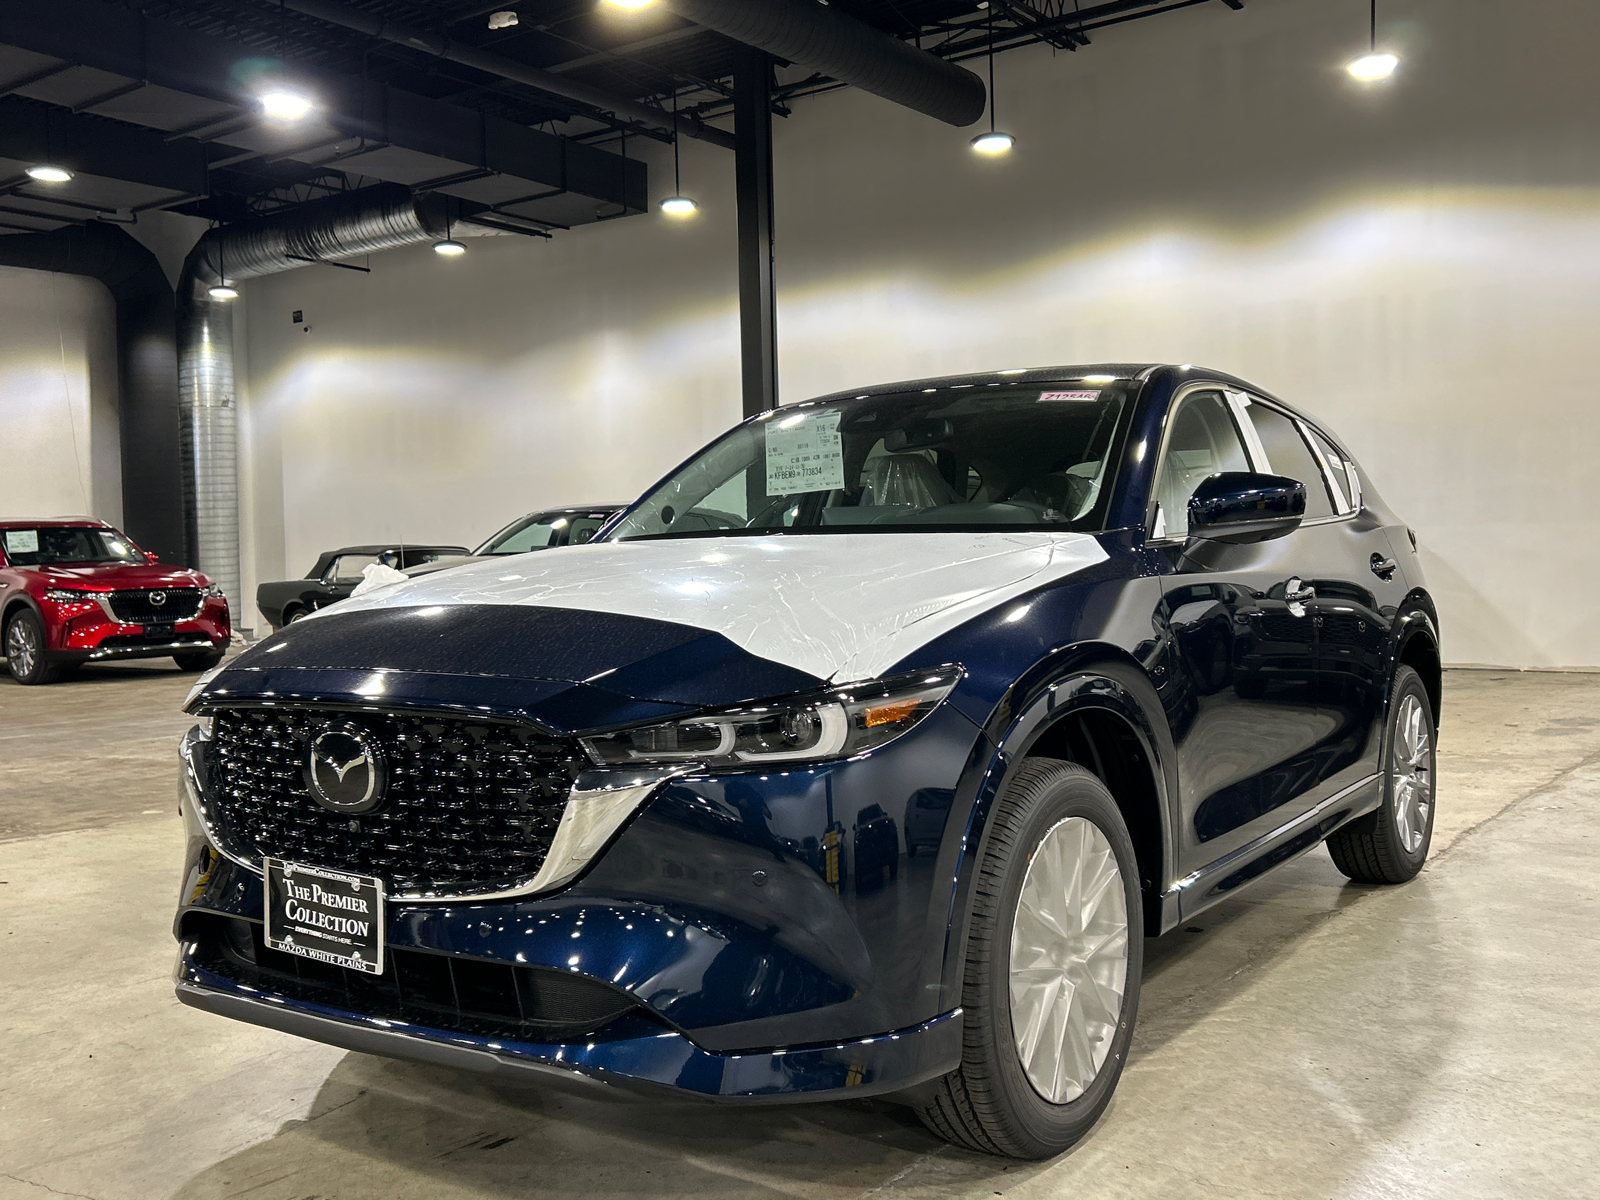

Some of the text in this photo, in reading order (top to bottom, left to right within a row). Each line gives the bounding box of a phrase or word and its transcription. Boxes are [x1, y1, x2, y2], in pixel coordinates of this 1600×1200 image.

[801, 466, 822, 477] 773834
[282, 877, 370, 914] THE PREMIER
[285, 898, 370, 937] COLLECTION
[294, 925, 323, 938] EVERYTHING
[322, 933, 338, 942] STARTS
[278, 942, 367, 971] MAZDA WHITE PLAINS
